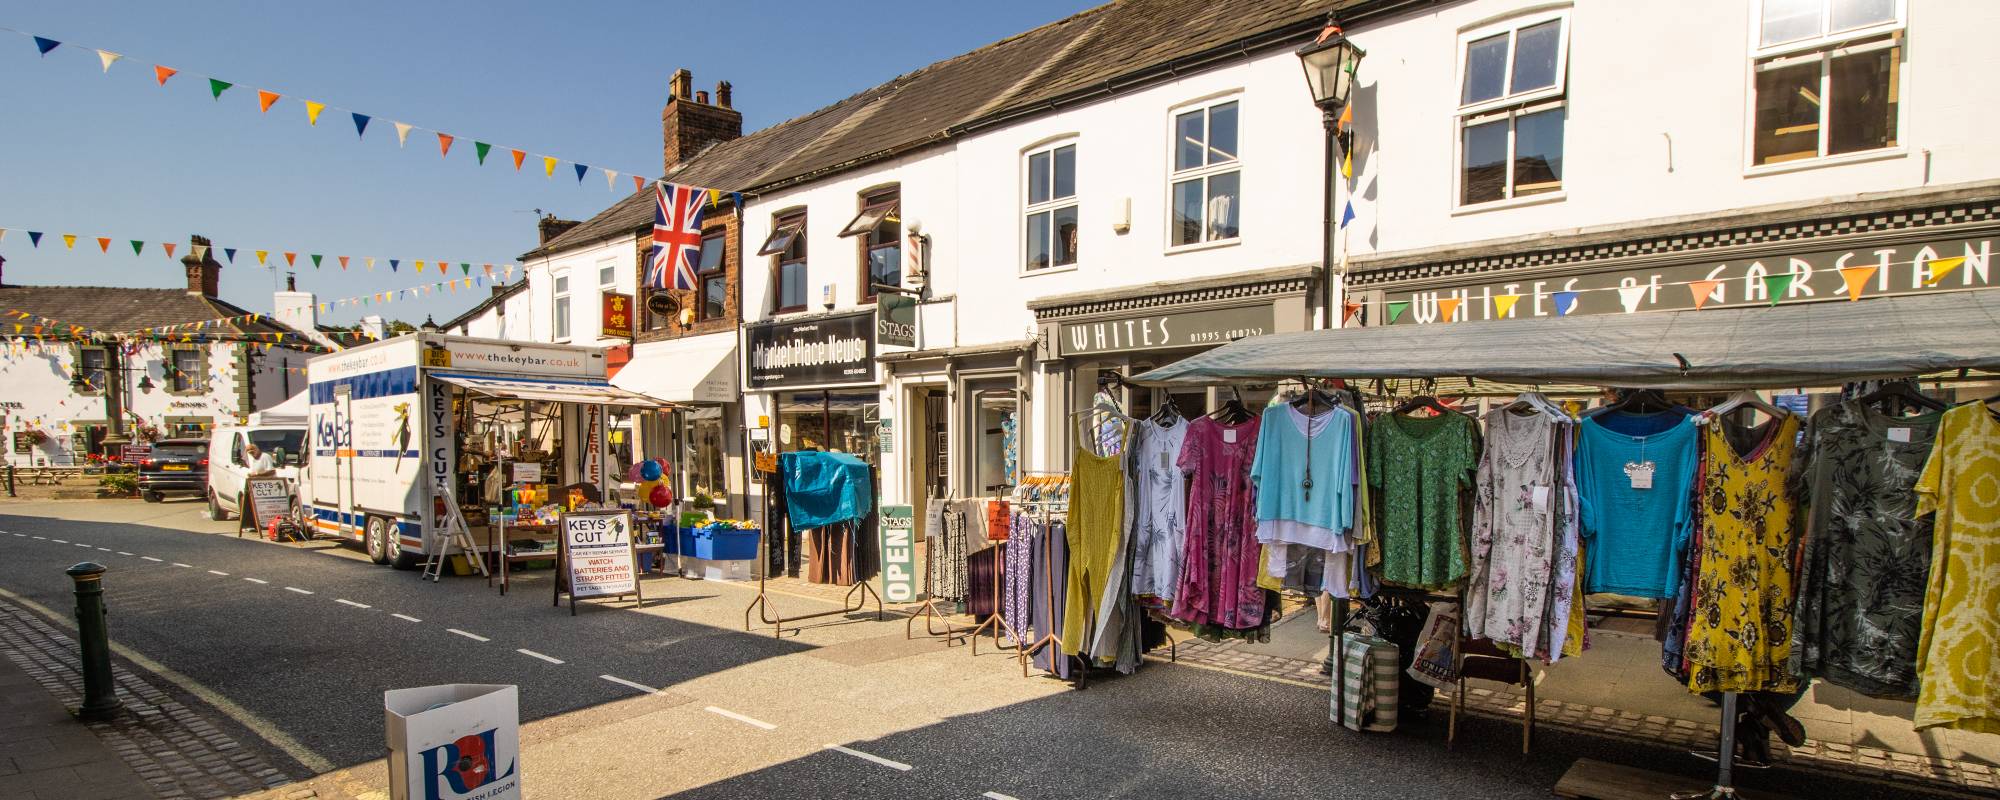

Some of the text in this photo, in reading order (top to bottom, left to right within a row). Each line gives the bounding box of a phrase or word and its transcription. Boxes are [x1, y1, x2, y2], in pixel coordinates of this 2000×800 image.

[1412, 278, 1579, 324] WHITES
[879, 319, 915, 338] STAGS
[1071, 317, 1170, 351] WHITES
[1190, 331, 1219, 342] 01995
[454, 352, 580, 367] www.thekeybar.co.uk
[756, 334, 861, 370] Market Place News
[433, 384, 445, 438] KEYS
[587, 404, 599, 484] ATTERIES
[568, 519, 606, 531] KEYS
[881, 516, 911, 528] STAGS
[574, 531, 603, 543] CUT
[574, 566, 613, 575] BATTERIES
[885, 529, 911, 601] OPEN
[488, 780, 515, 798] LEGION
